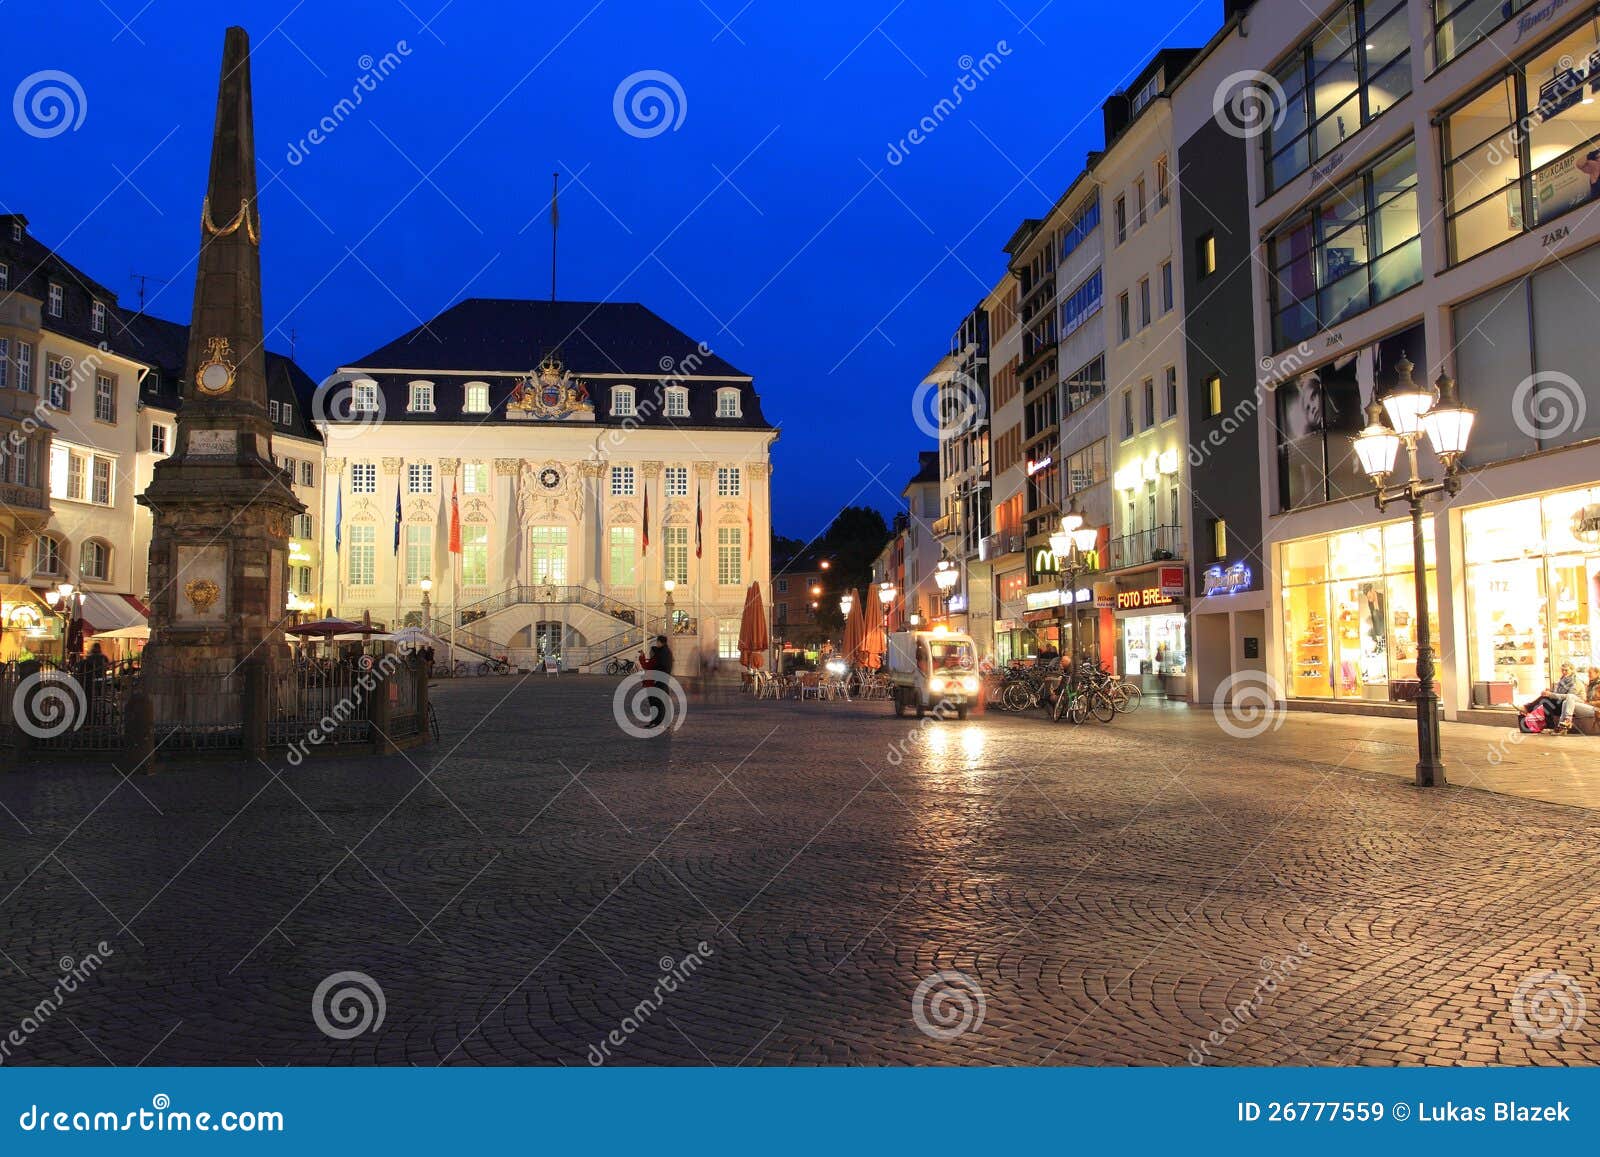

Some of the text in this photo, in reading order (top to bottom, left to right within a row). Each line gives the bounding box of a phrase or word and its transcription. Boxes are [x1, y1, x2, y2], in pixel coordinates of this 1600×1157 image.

[1542, 226, 1570, 247] ZARA
[1326, 333, 1343, 347] ZARA
[1117, 591, 1140, 608] FOTO
